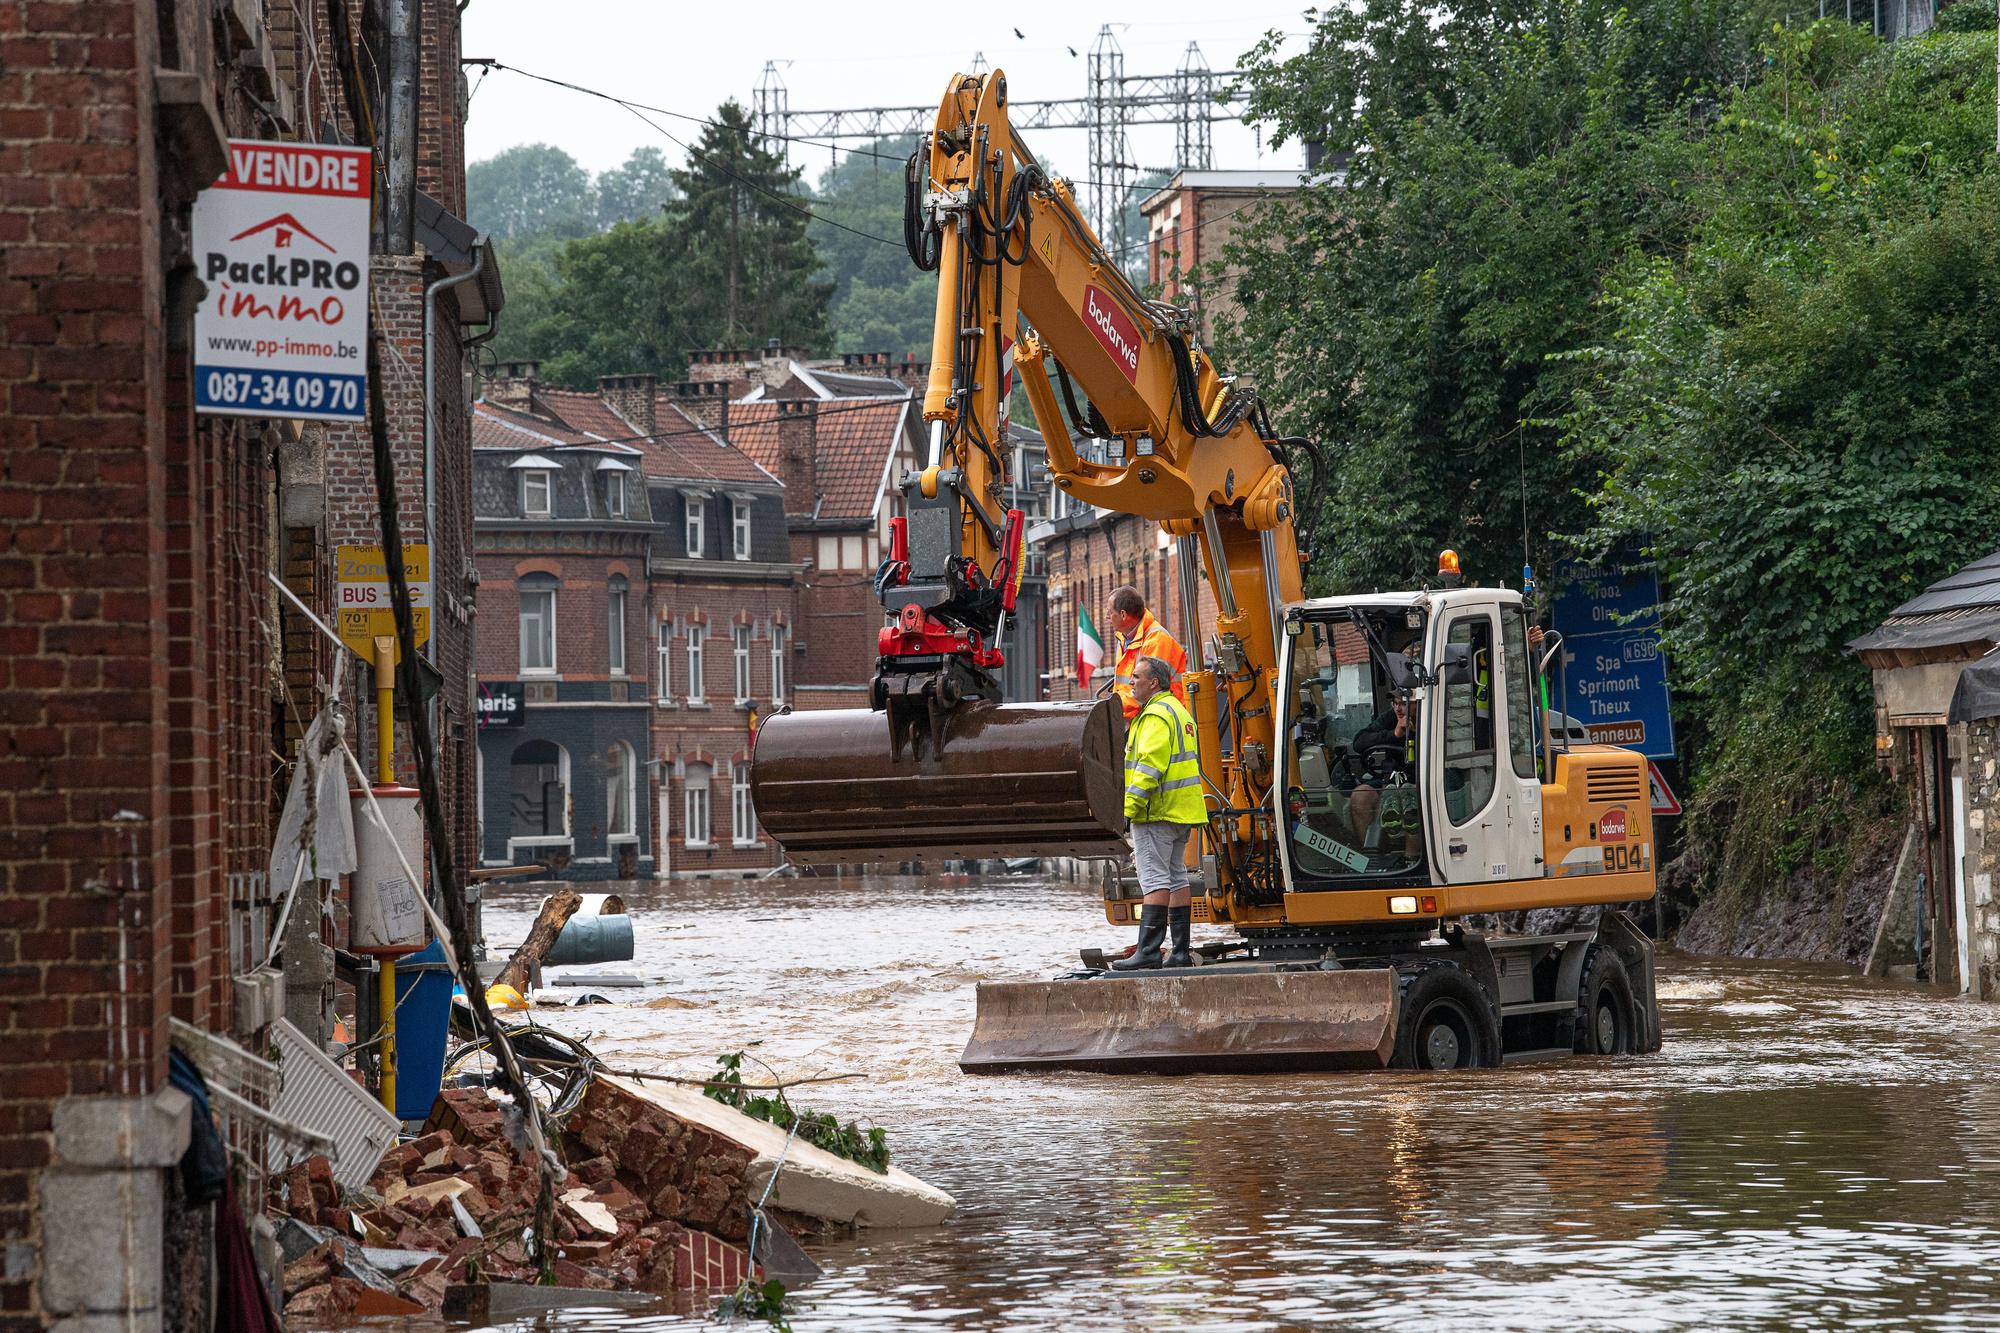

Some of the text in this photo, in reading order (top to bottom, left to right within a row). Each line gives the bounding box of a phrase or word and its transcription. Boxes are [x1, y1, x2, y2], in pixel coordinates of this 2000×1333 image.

[232, 150, 358, 191] VENDRE
[206, 252, 360, 290] PackPRO
[218, 282, 344, 325] immo
[1088, 289, 1137, 369] bodarwé
[208, 336, 358, 359] www.pp-immo.be
[295, 377, 325, 407] 09
[329, 380, 358, 410] 70
[343, 561, 420, 576] Zon 21
[343, 587, 377, 602] BUS
[345, 613, 368, 624] 701
[1596, 656, 1621, 674] Spa
[1578, 675, 1640, 697] Sprimont
[1590, 700, 1631, 715] Theux
[1601, 818, 1625, 835] bodarwé
[1308, 833, 1355, 865] BOULE
[1604, 844, 1641, 871] 904
